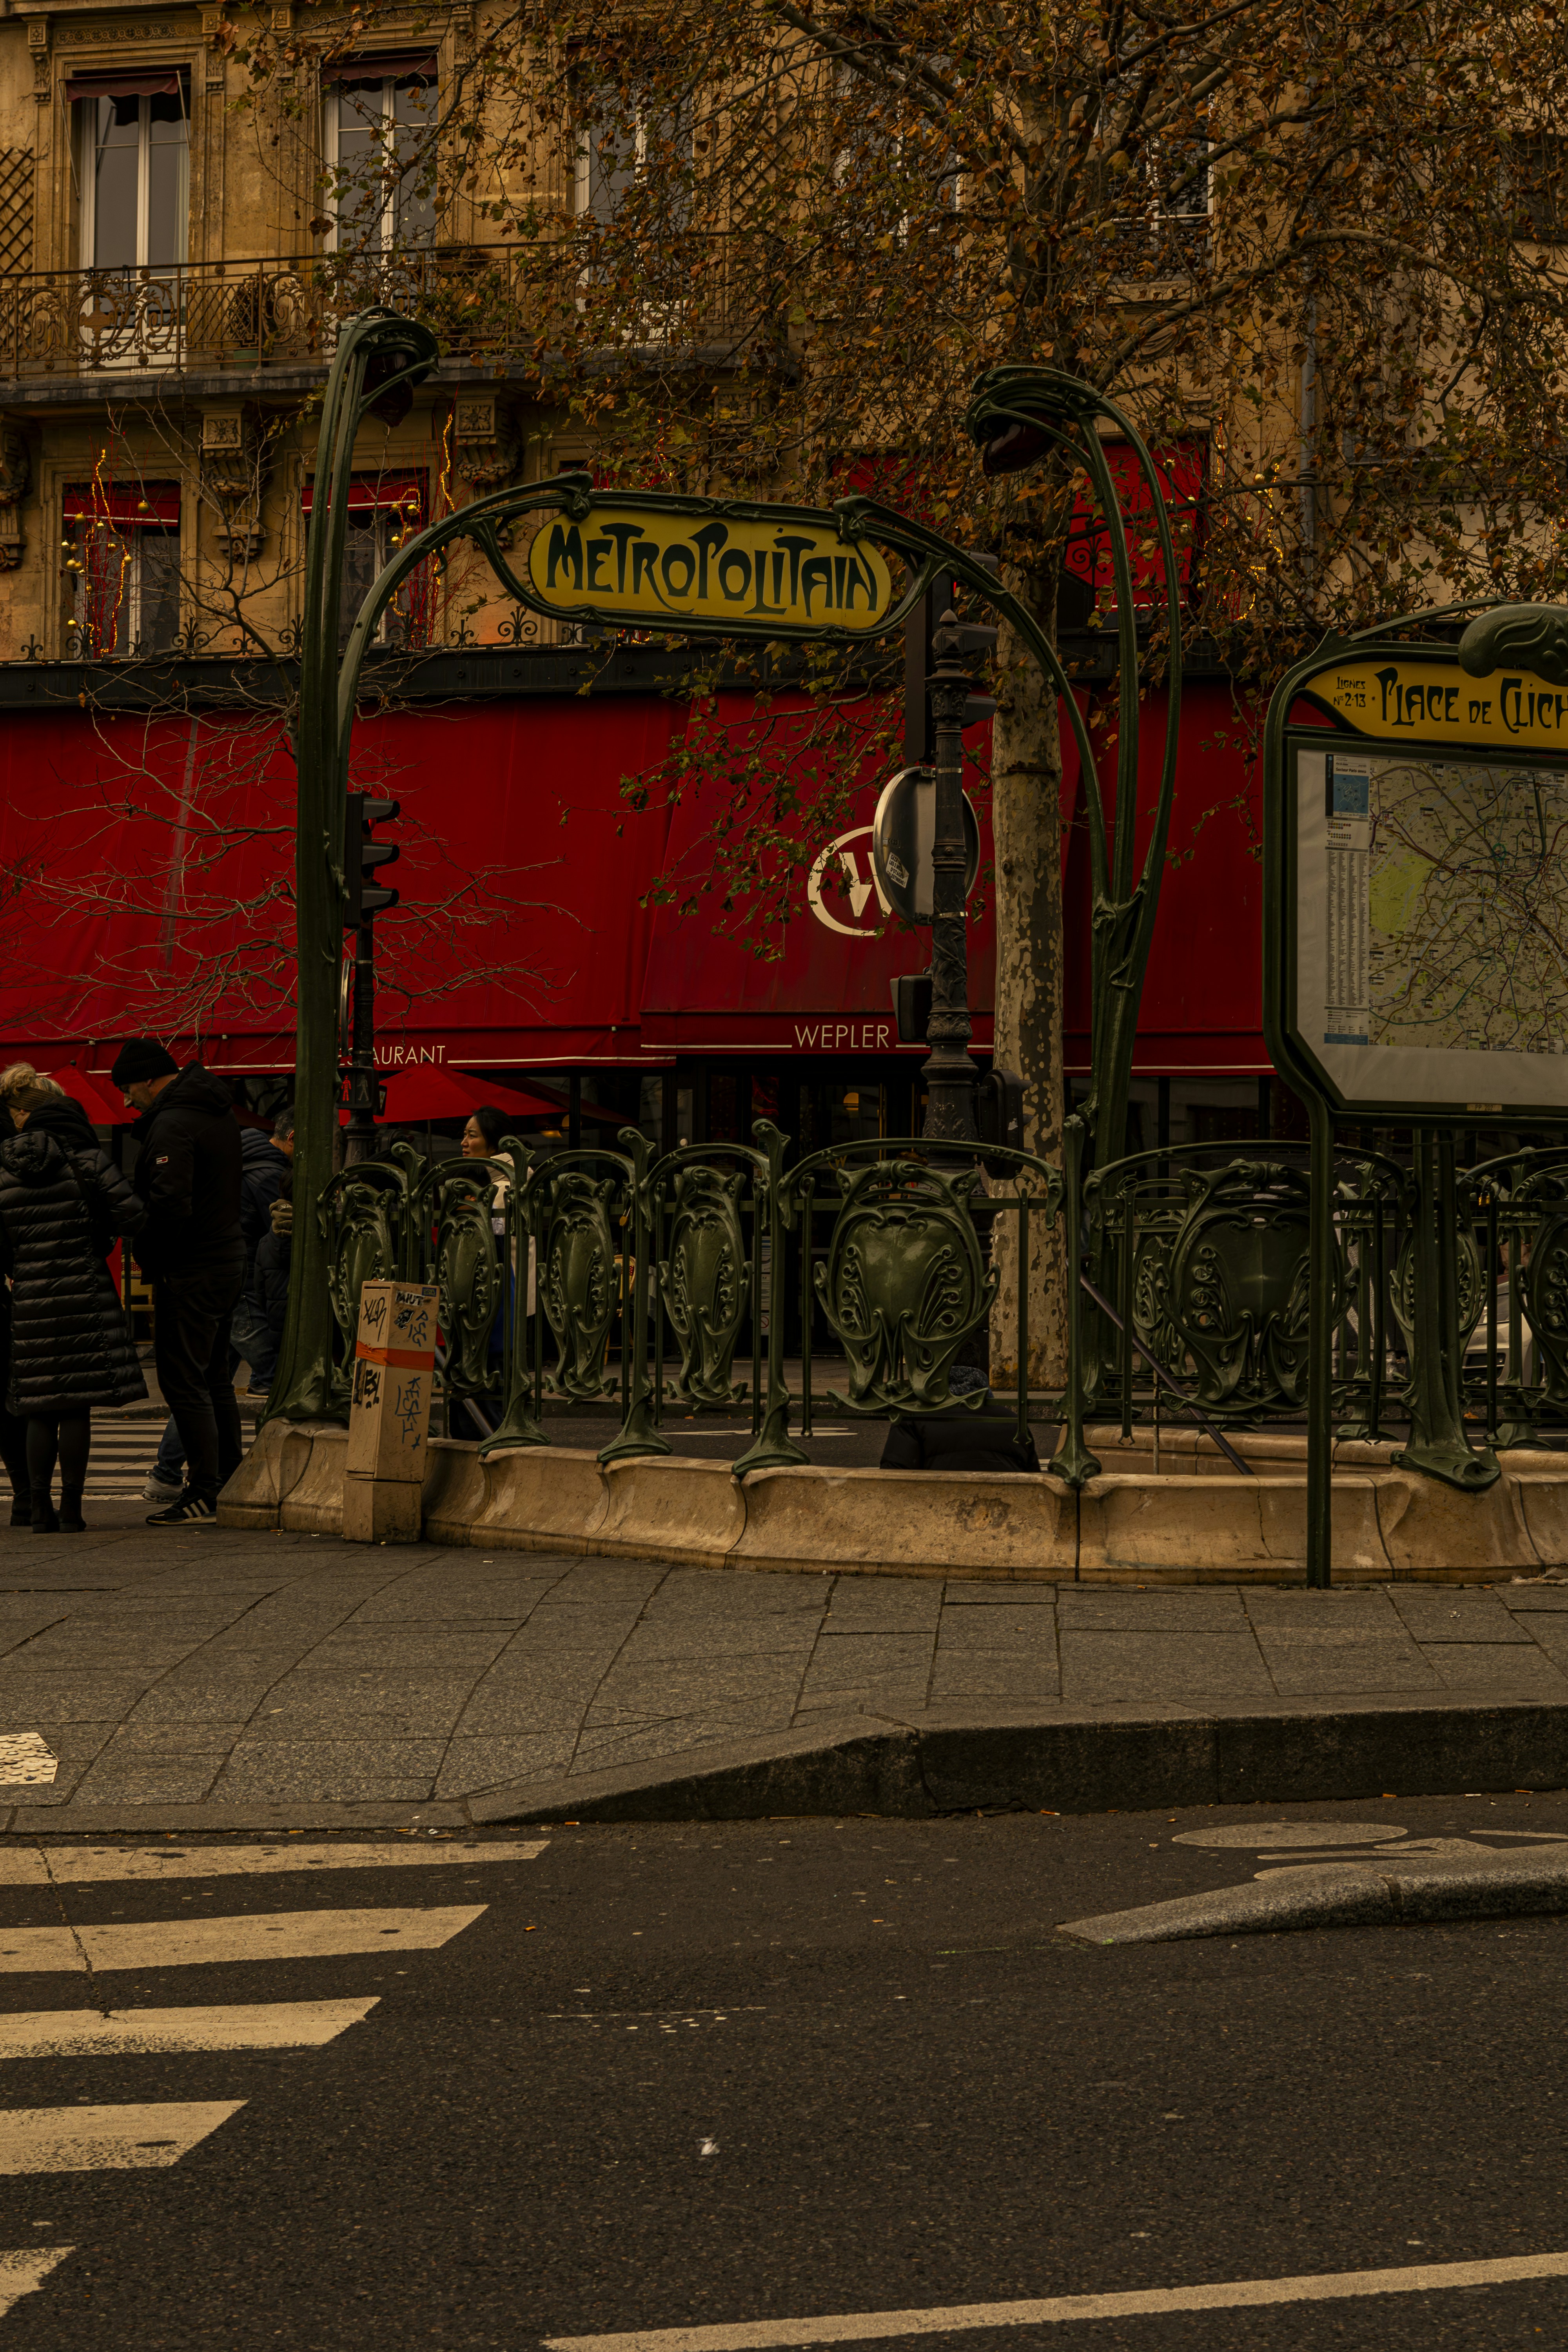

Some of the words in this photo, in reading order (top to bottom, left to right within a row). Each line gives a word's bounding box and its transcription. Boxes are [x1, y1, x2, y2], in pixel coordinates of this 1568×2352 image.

[545, 521, 877, 618] METROPOLITAIN
[1336, 676, 1366, 689] LIGNES
[1374, 667, 1459, 726] PLACE
[1469, 700, 1492, 724] DE
[794, 1025, 889, 1049] WEPLER
